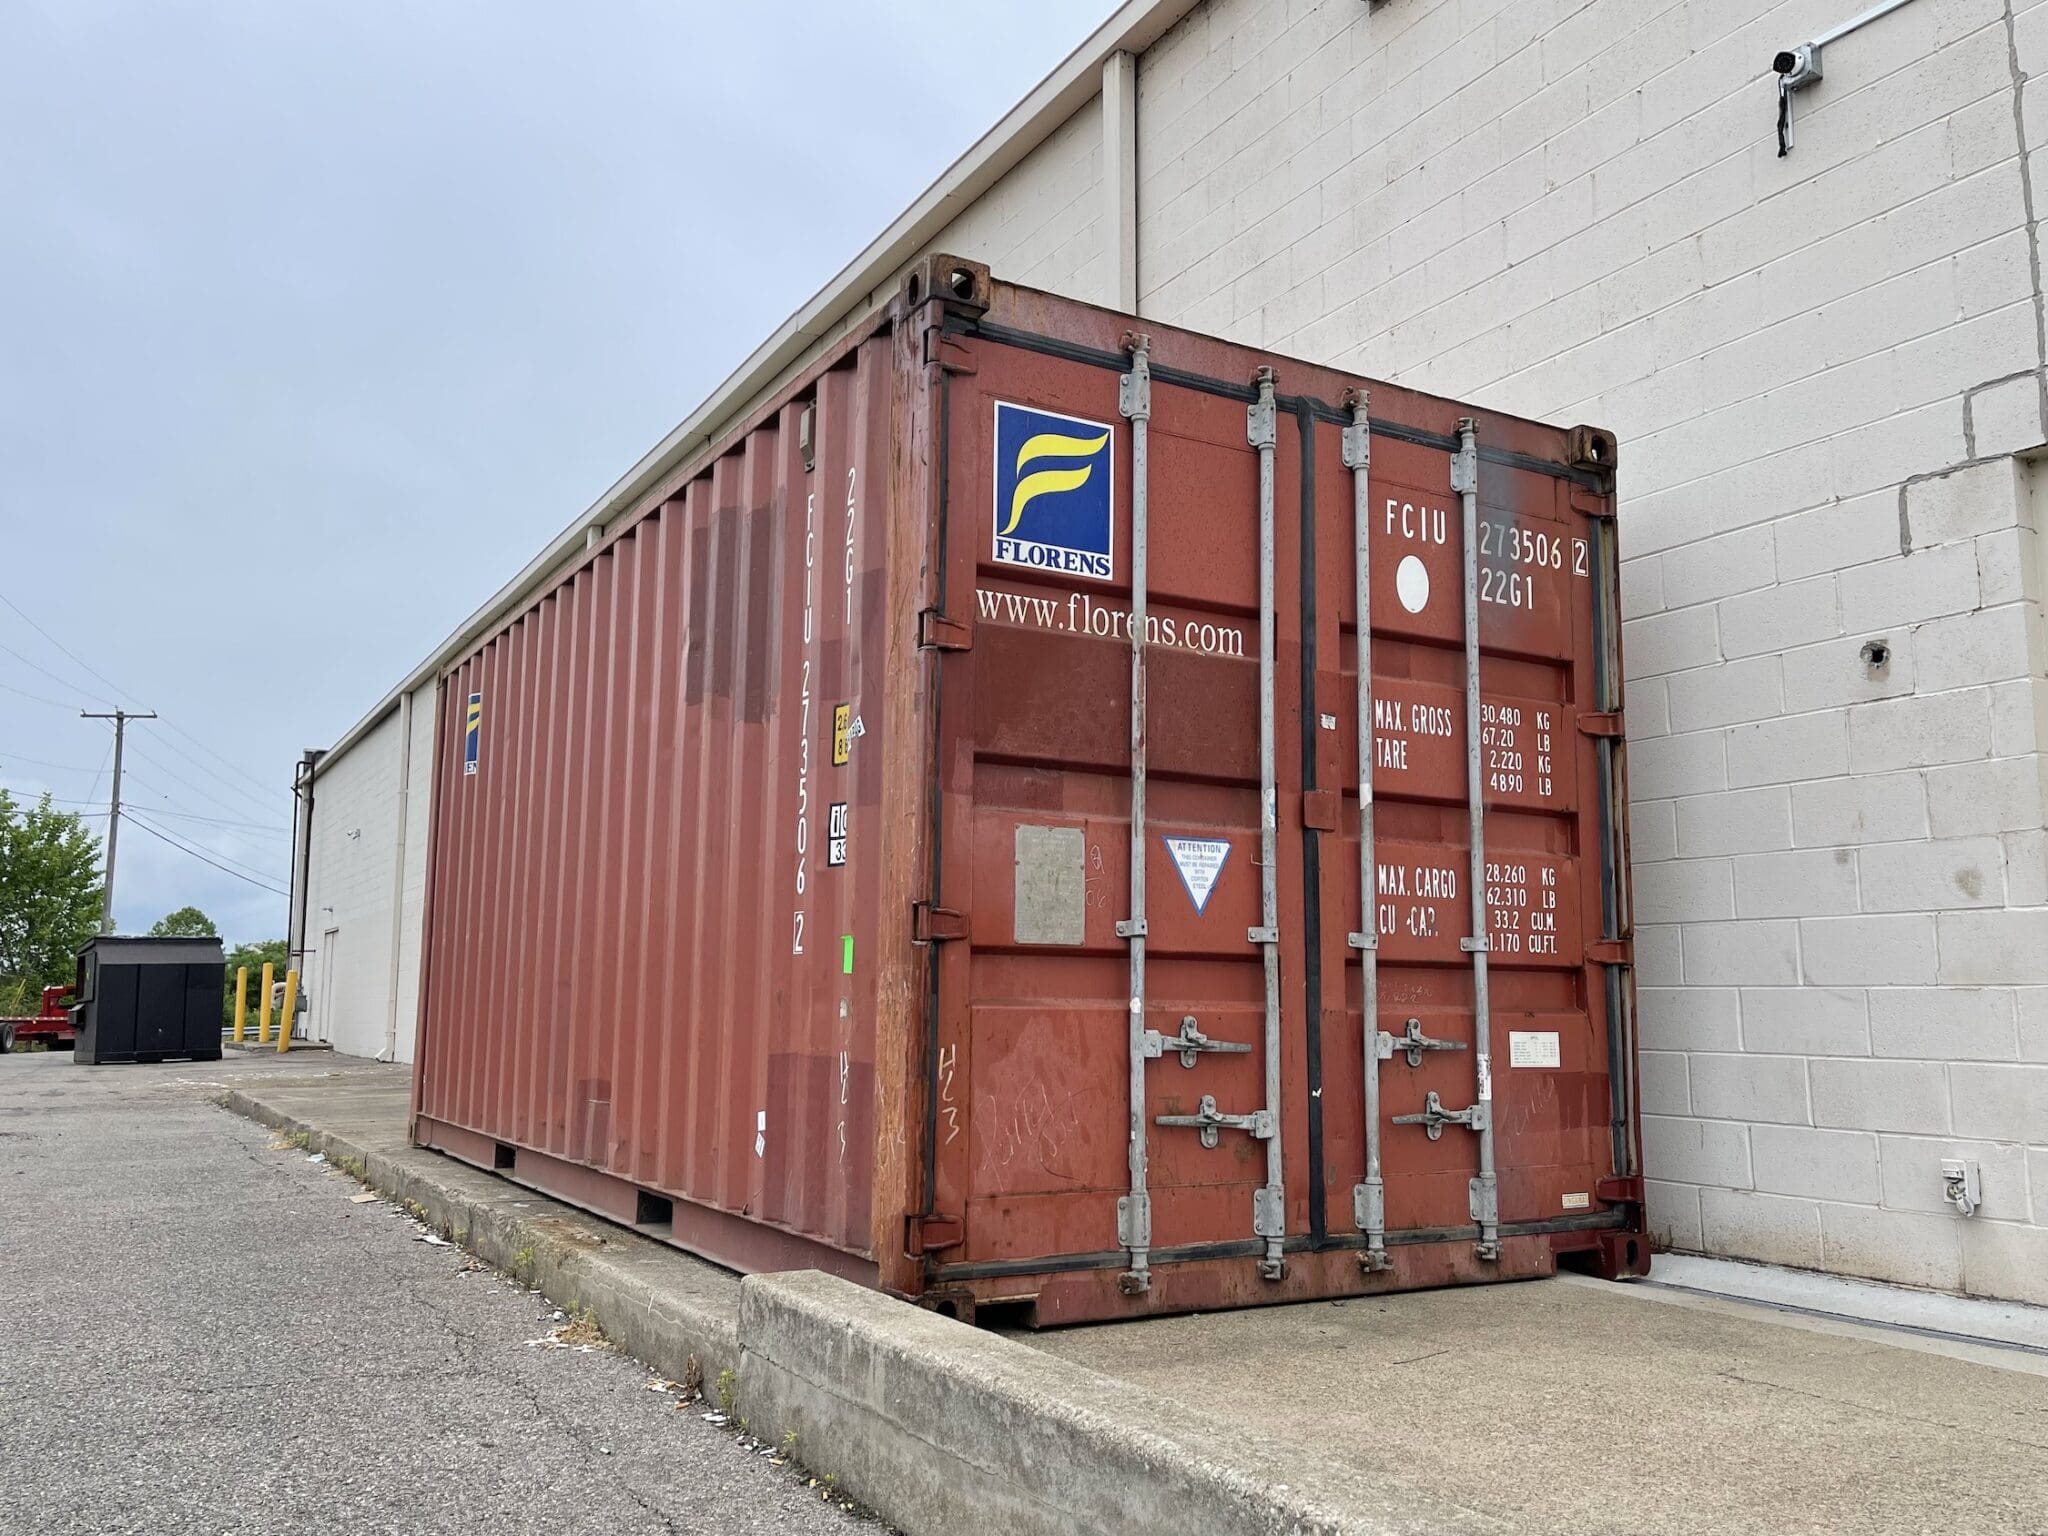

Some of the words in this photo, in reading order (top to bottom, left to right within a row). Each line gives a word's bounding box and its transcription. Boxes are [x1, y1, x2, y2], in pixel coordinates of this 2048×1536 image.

[845, 467, 856, 624] 22G1
[1386, 499, 1446, 545] FCIU
[1480, 521, 1562, 570] 273506
[1574, 541, 1586, 574] 2
[804, 493, 815, 643] FCIU
[996, 538, 1111, 576] FLORENS
[1481, 567, 1533, 610] 22G1
[1375, 699, 1407, 732] MAX.
[1412, 704, 1452, 737] GROSS
[1536, 712, 1550, 730] KG
[1376, 737, 1408, 770] TARE
[1537, 734, 1551, 752] LB
[796, 661, 810, 894] 273506
[1538, 755, 1551, 774] KG
[1490, 772, 1523, 793] 4890
[1538, 777, 1552, 796] LB
[1177, 842, 1221, 853] ATTENTION
[1378, 864, 1411, 896] MAX.
[1416, 867, 1456, 899] CARGO
[1542, 867, 1555, 886] KG
[1543, 890, 1556, 908] LB
[1494, 910, 1520, 929] 33.2
